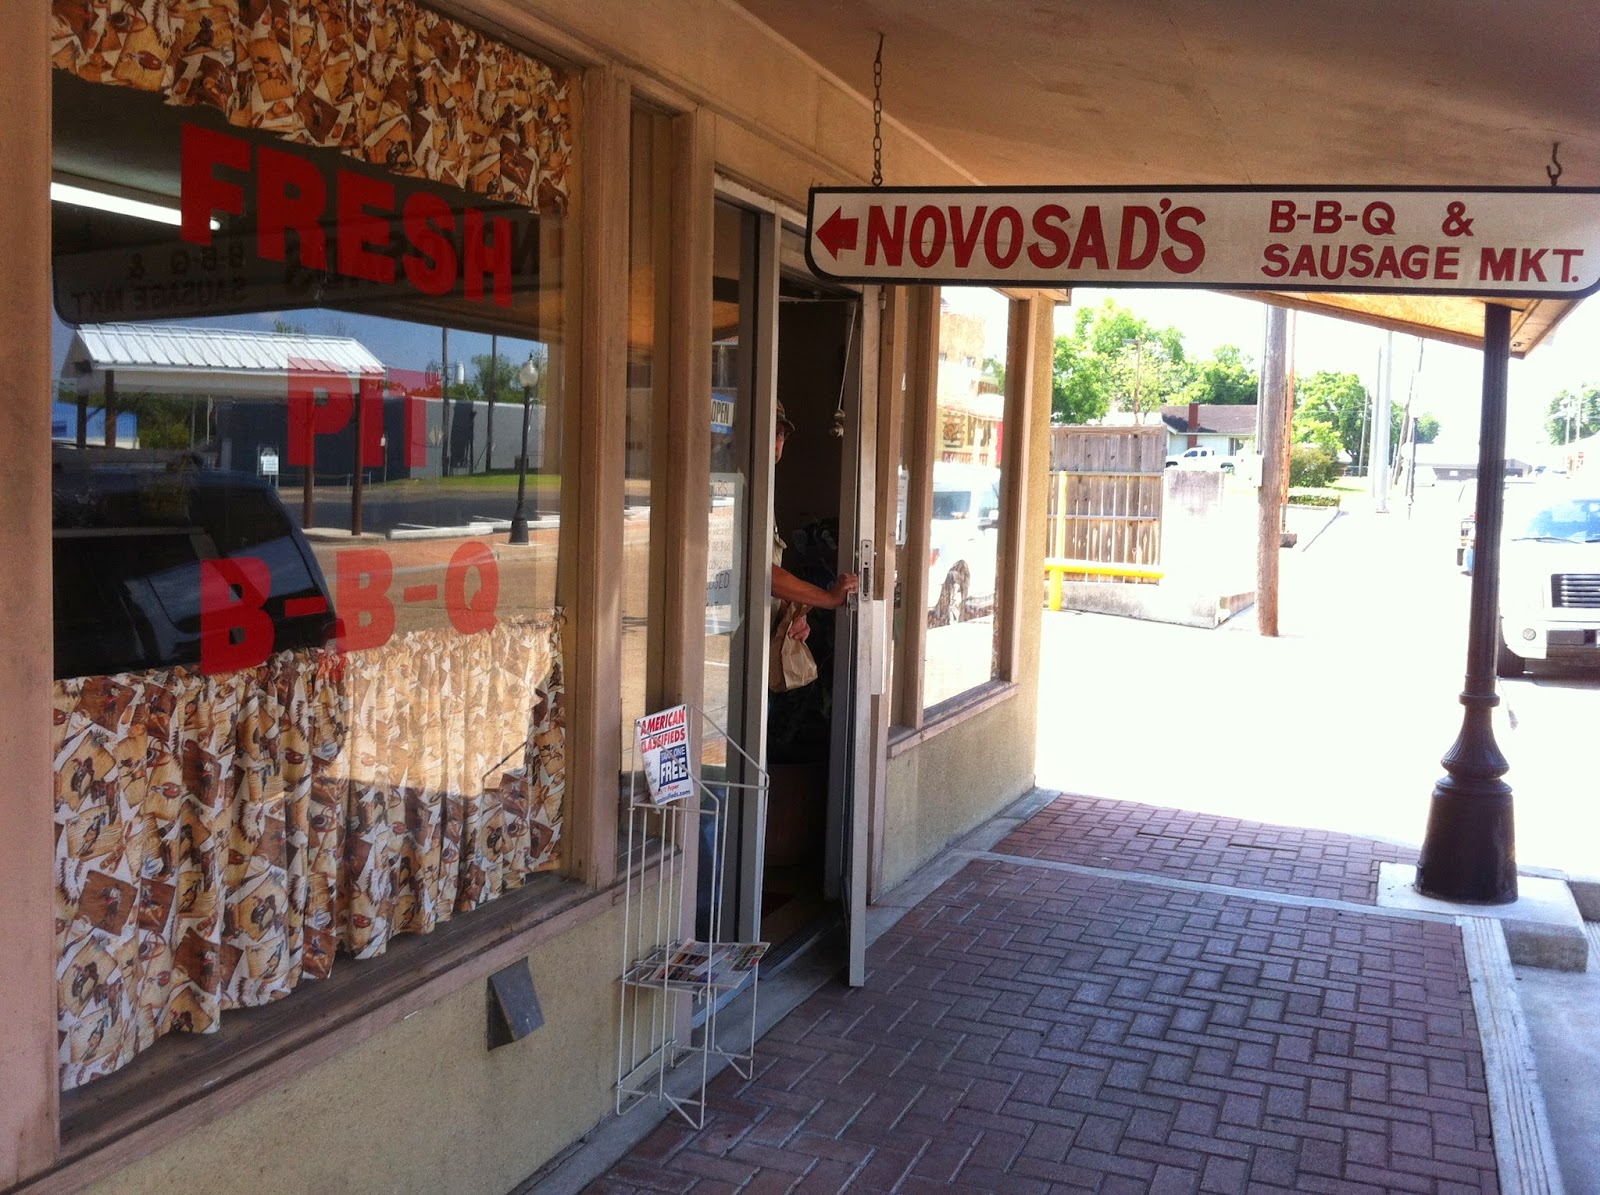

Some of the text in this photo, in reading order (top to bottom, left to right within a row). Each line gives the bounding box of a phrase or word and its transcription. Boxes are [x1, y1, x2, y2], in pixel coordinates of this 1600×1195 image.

[181, 123, 512, 308] FRESH
[1269, 200, 1475, 237] B-B-Q &
[865, 197, 1206, 274] NOVOSAD'S
[1261, 243, 1584, 283] SAUSAGE MKT.
[287, 354, 442, 467] PIT
[711, 402, 729, 424] OPEN
[201, 541, 499, 677] B-B-Q
[641, 709, 685, 736] AMERICAN
[641, 728, 686, 753] CLASSIFIEDS
[673, 746, 686, 758] ONE
[661, 758, 687, 784] FREE
